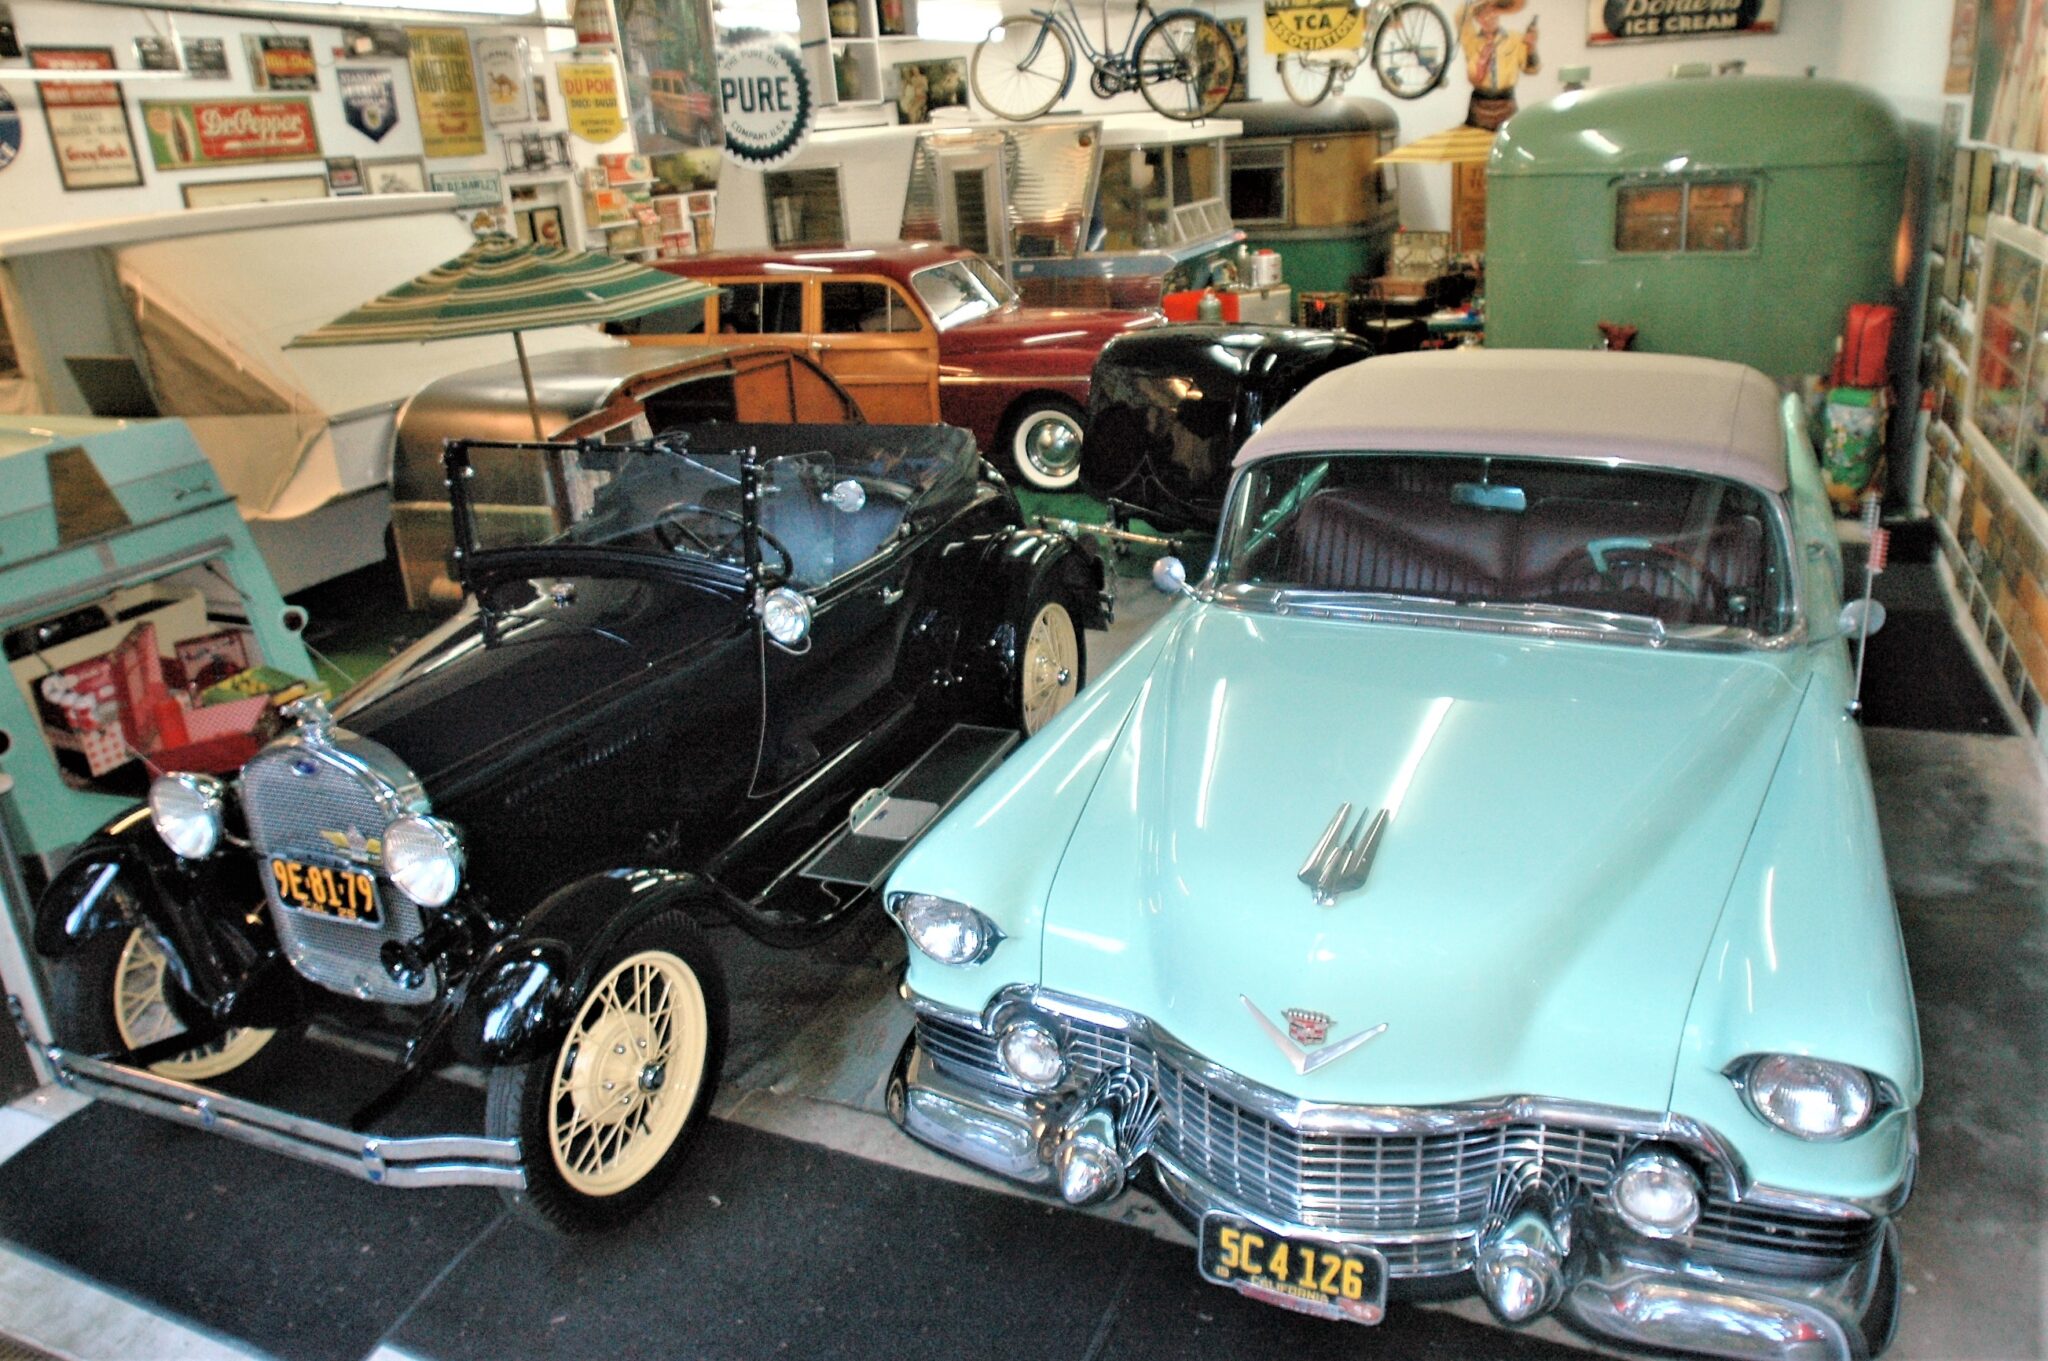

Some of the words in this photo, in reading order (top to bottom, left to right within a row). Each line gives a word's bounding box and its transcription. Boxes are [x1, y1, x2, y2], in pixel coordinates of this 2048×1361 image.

[1267, 14, 1358, 50] ASSOCIATION
[1293, 14, 1332, 31] TCA
[1624, 17, 1660, 35] ICE
[1664, 13, 1739, 33] CREAM
[565, 79, 583, 95] DU
[720, 75, 793, 114] PURE
[233, 106, 304, 143] Pepper
[731, 119, 769, 139] COMPANY
[1220, 1227, 1265, 1275] 5C
[1269, 1242, 1290, 1282] 4
[1298, 1247, 1365, 1300] 126
[1250, 1274, 1329, 1304] CALIFORNIA
